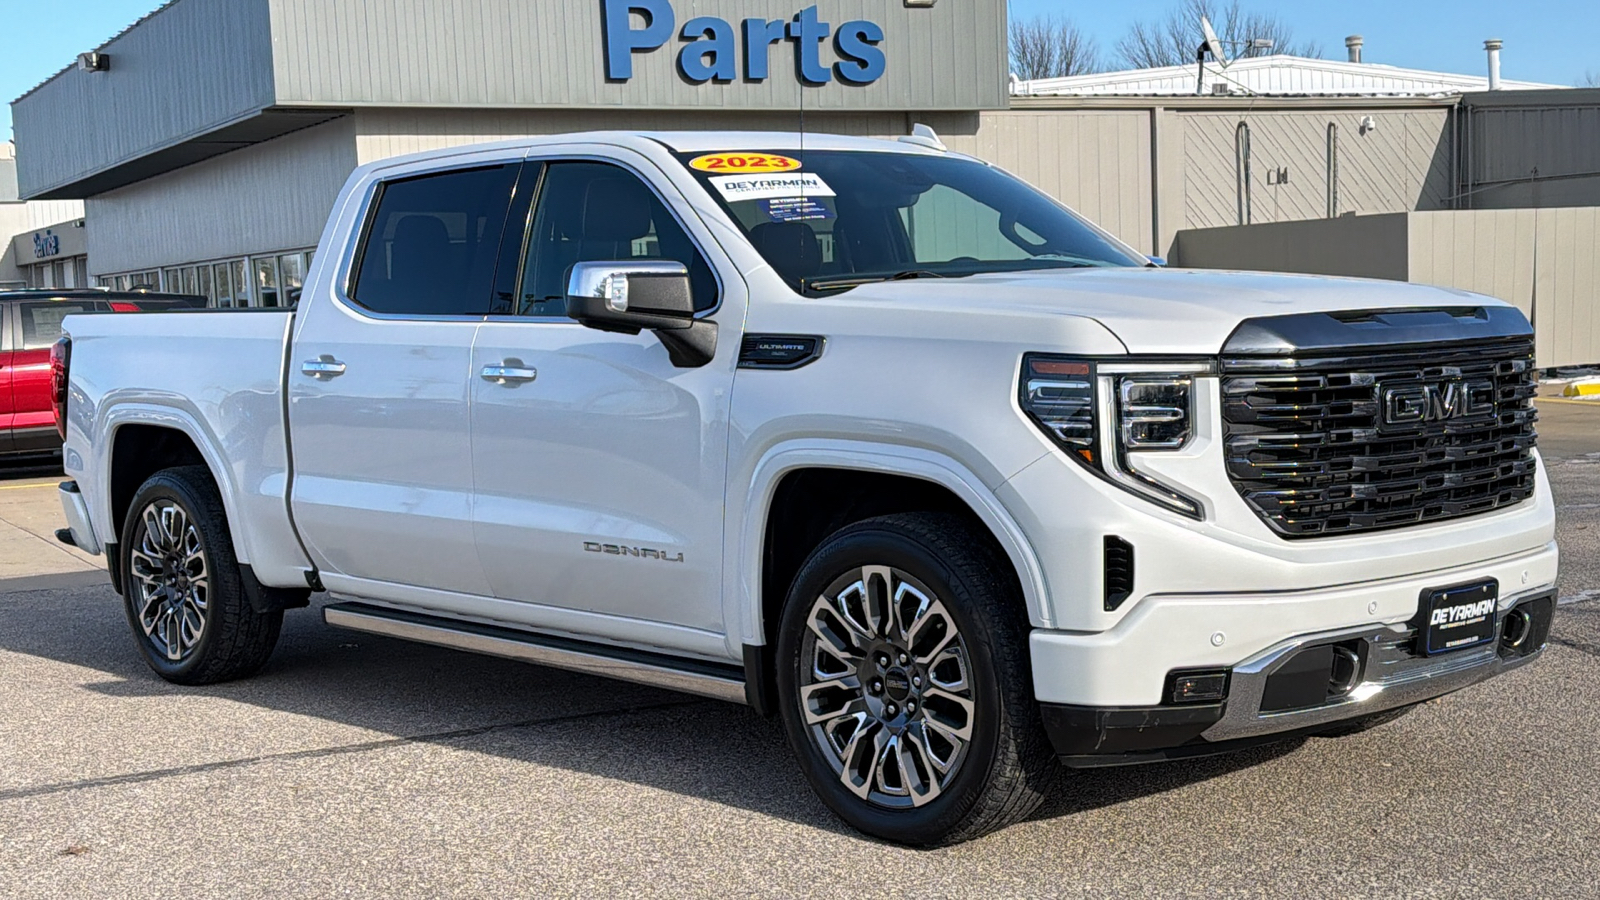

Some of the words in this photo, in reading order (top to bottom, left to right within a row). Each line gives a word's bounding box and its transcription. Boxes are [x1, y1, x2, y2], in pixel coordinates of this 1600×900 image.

[603, 0, 886, 86] Parts
[705, 156, 791, 169] 2023
[724, 179, 818, 190] DEYARMAN
[735, 185, 775, 193] CERTIFIED
[1386, 382, 1493, 423] GMC
[583, 541, 684, 563] DENALI
[1430, 598, 1496, 626] DEYARMAN
